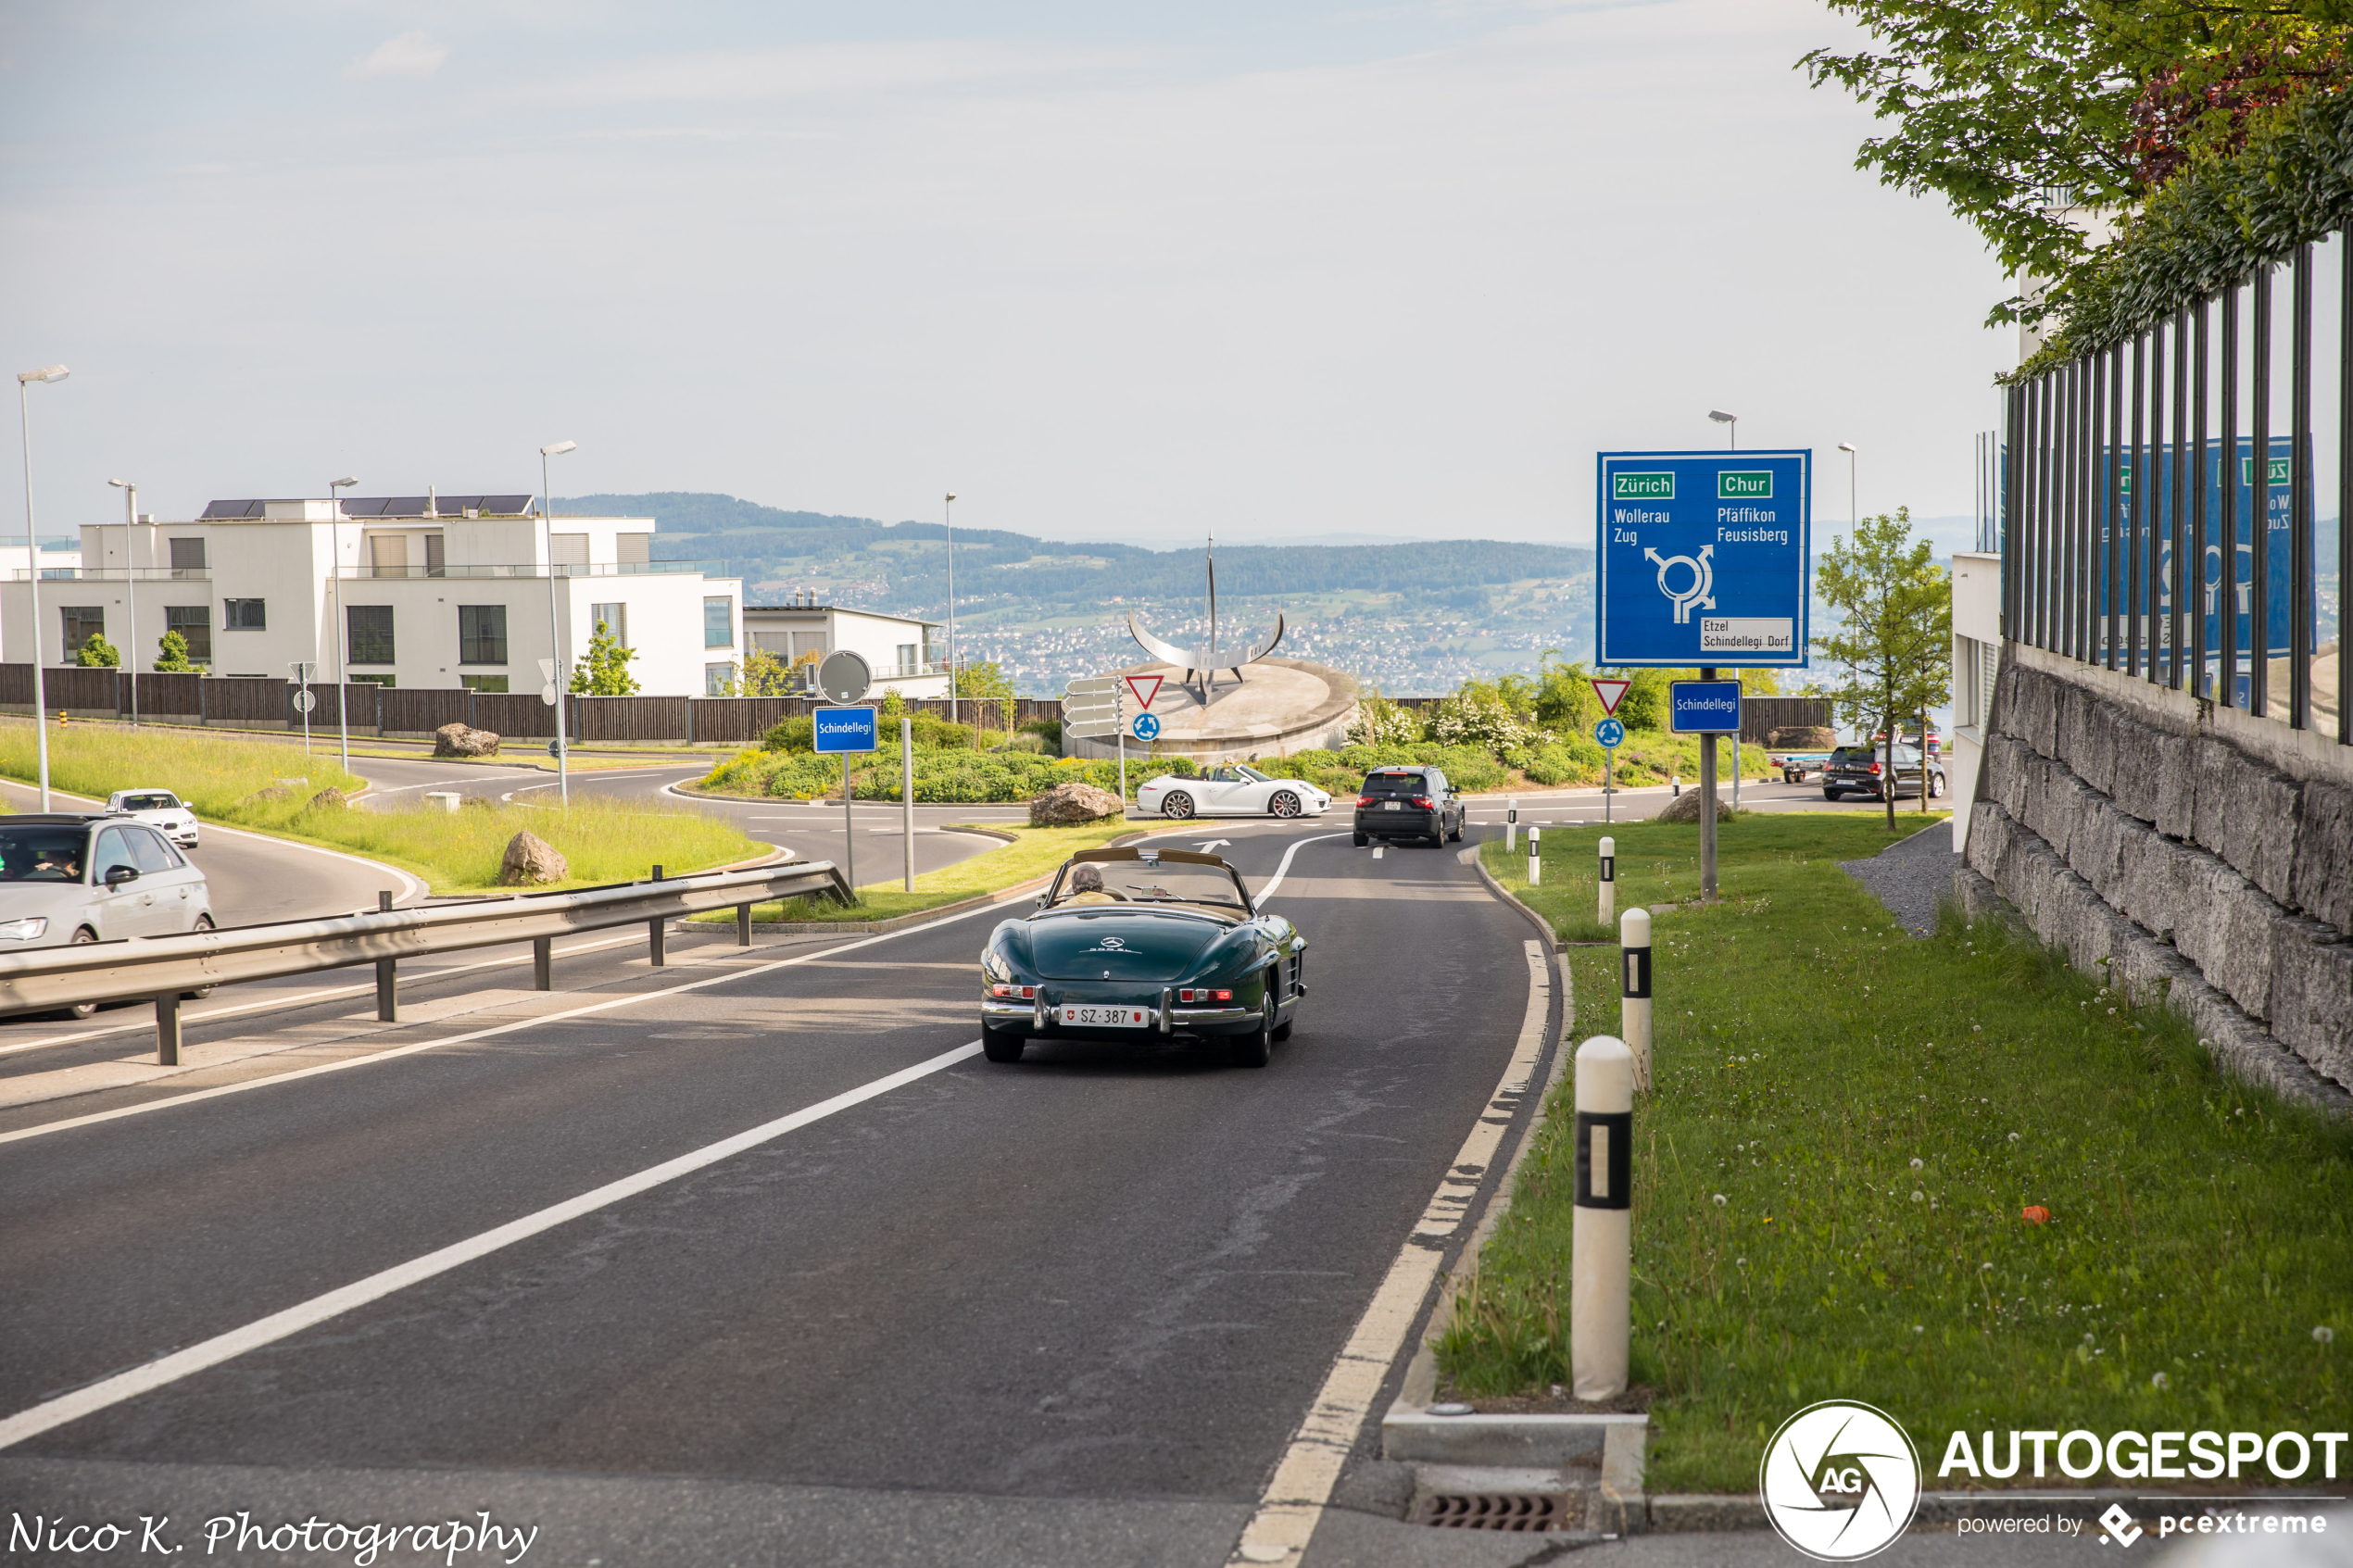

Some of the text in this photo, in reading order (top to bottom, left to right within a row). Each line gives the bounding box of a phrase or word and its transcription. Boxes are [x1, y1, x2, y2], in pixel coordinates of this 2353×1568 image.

[1617, 478, 1670, 493] Zürich
[1725, 477, 1766, 492] Chur
[1614, 508, 1670, 523] Wollerau
[1718, 508, 1776, 522] Pfäffikon
[1614, 528, 1637, 546] Zug
[1718, 527, 1788, 546] Feusisberg
[1704, 621, 1729, 632] Etzel
[1704, 635, 1789, 650] Schindellegi Dorf
[1677, 698, 1736, 713] Schindellegi
[819, 721, 872, 735] Schindellegi
